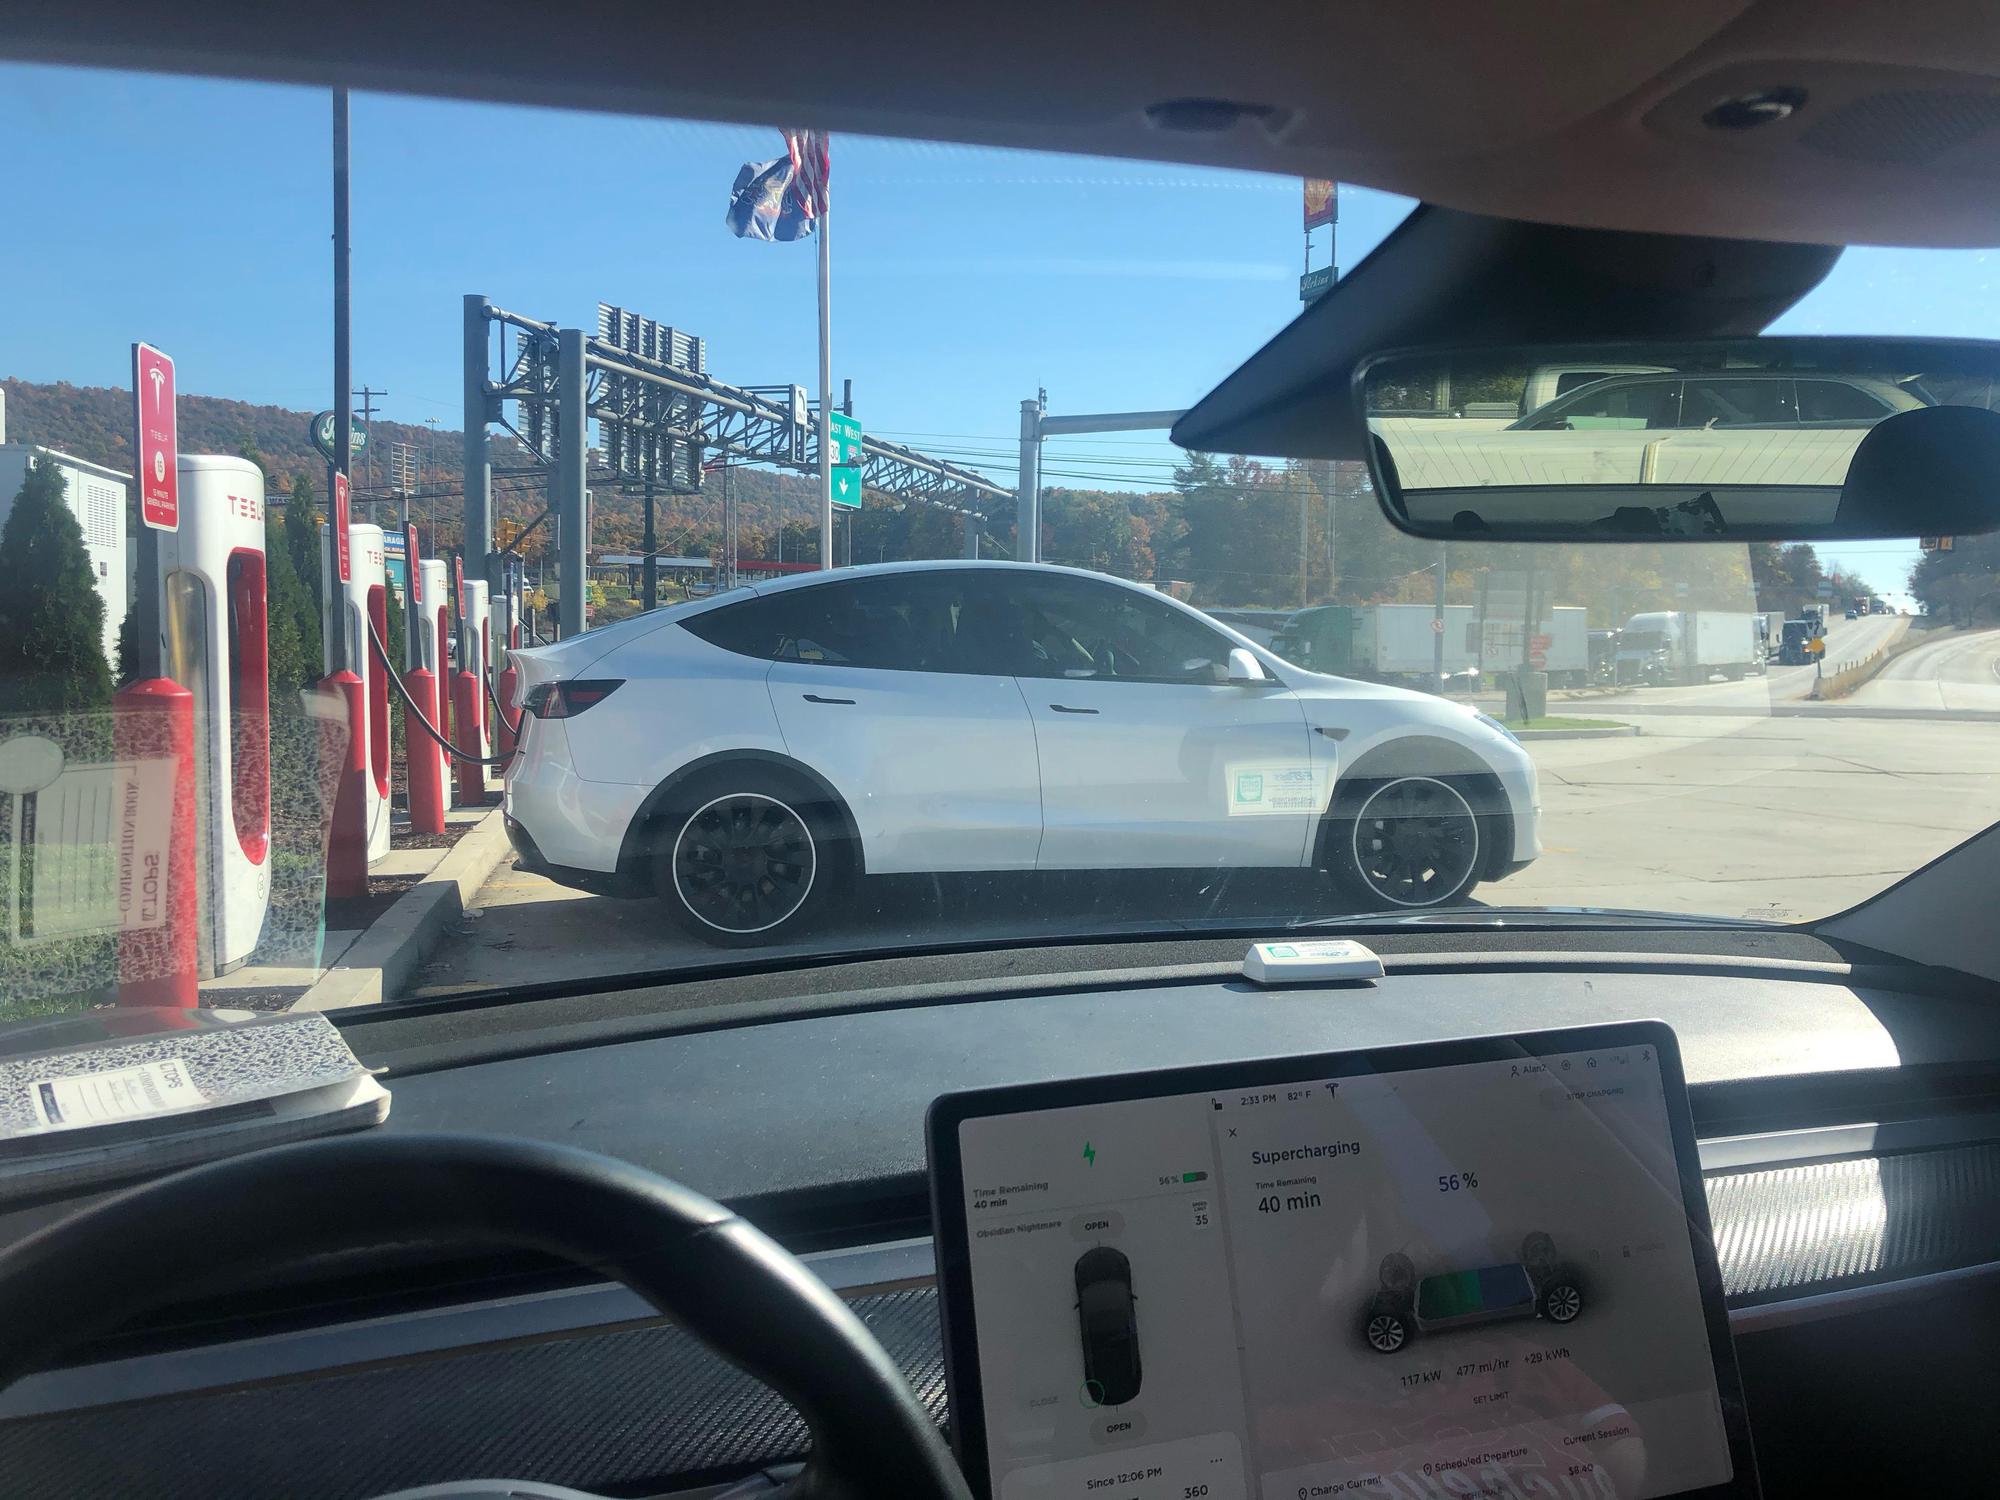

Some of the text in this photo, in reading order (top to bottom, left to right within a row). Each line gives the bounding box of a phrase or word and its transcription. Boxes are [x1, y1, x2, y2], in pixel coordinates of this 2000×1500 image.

[831, 422, 861, 441] AST WEST
[831, 443, 839, 461] 30
[383, 536, 405, 545] ARAGE
[1241, 1095, 1260, 1106] 2:33
[1262, 1094, 1277, 1104] PM
[1251, 1140, 1361, 1167] Supercharging
[973, 1181, 1049, 1198] Time Remaining
[1256, 1174, 1318, 1191] Time Remaining
[974, 1197, 1008, 1209] 40 min
[1258, 1190, 1322, 1214] 40 min
[1084, 1220, 1110, 1232] OPEN
[1195, 1214, 1209, 1226] 35
[976, 1220, 1062, 1238] Obsidian Nightmare
[1546, 1347, 1571, 1361] kWh
[1456, 1357, 1512, 1378] 477 mi/hr
[1401, 1370, 1442, 1387] 117 kW
[1472, 1391, 1511, 1405] SET LIMIT
[1106, 1421, 1133, 1434] OPEN
[1563, 1426, 1630, 1446] Current Session
[1434, 1446, 1528, 1473] Scheduled Departure
[1086, 1467, 1163, 1490] Since 12:06 PM
[1310, 1474, 1383, 1497] Charge Current
[1184, 1484, 1209, 1499] 360
